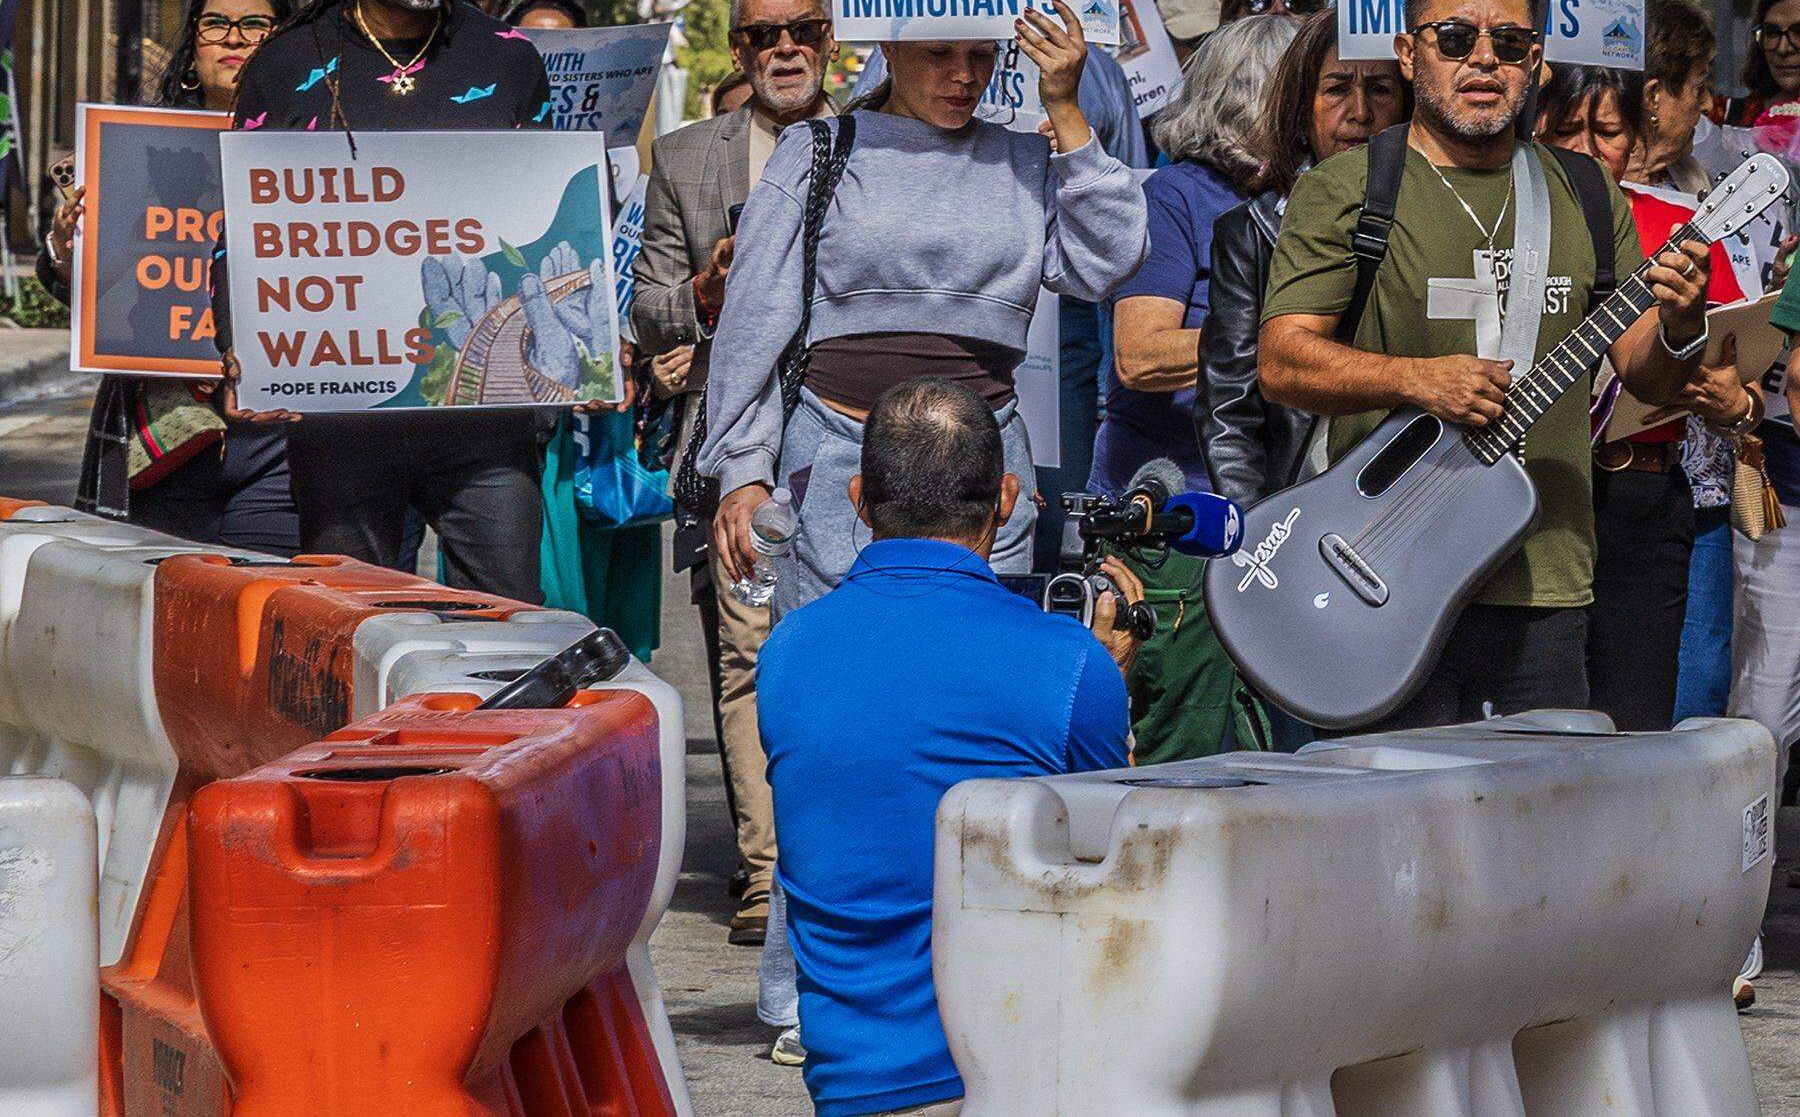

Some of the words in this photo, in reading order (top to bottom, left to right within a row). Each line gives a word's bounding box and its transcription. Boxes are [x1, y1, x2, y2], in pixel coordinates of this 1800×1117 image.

[563, 70, 604, 83] SISTERS
[605, 69, 630, 80] WHO
[631, 65, 654, 76] ARE
[581, 83, 600, 111] &
[249, 166, 405, 204] BUILD
[253, 217, 485, 258] BRIDGES
[257, 275, 364, 313] NOT
[1546, 276, 1572, 287] ROUGH
[257, 327, 436, 368] WALLS
[320, 379, 397, 396] FRANCIS
